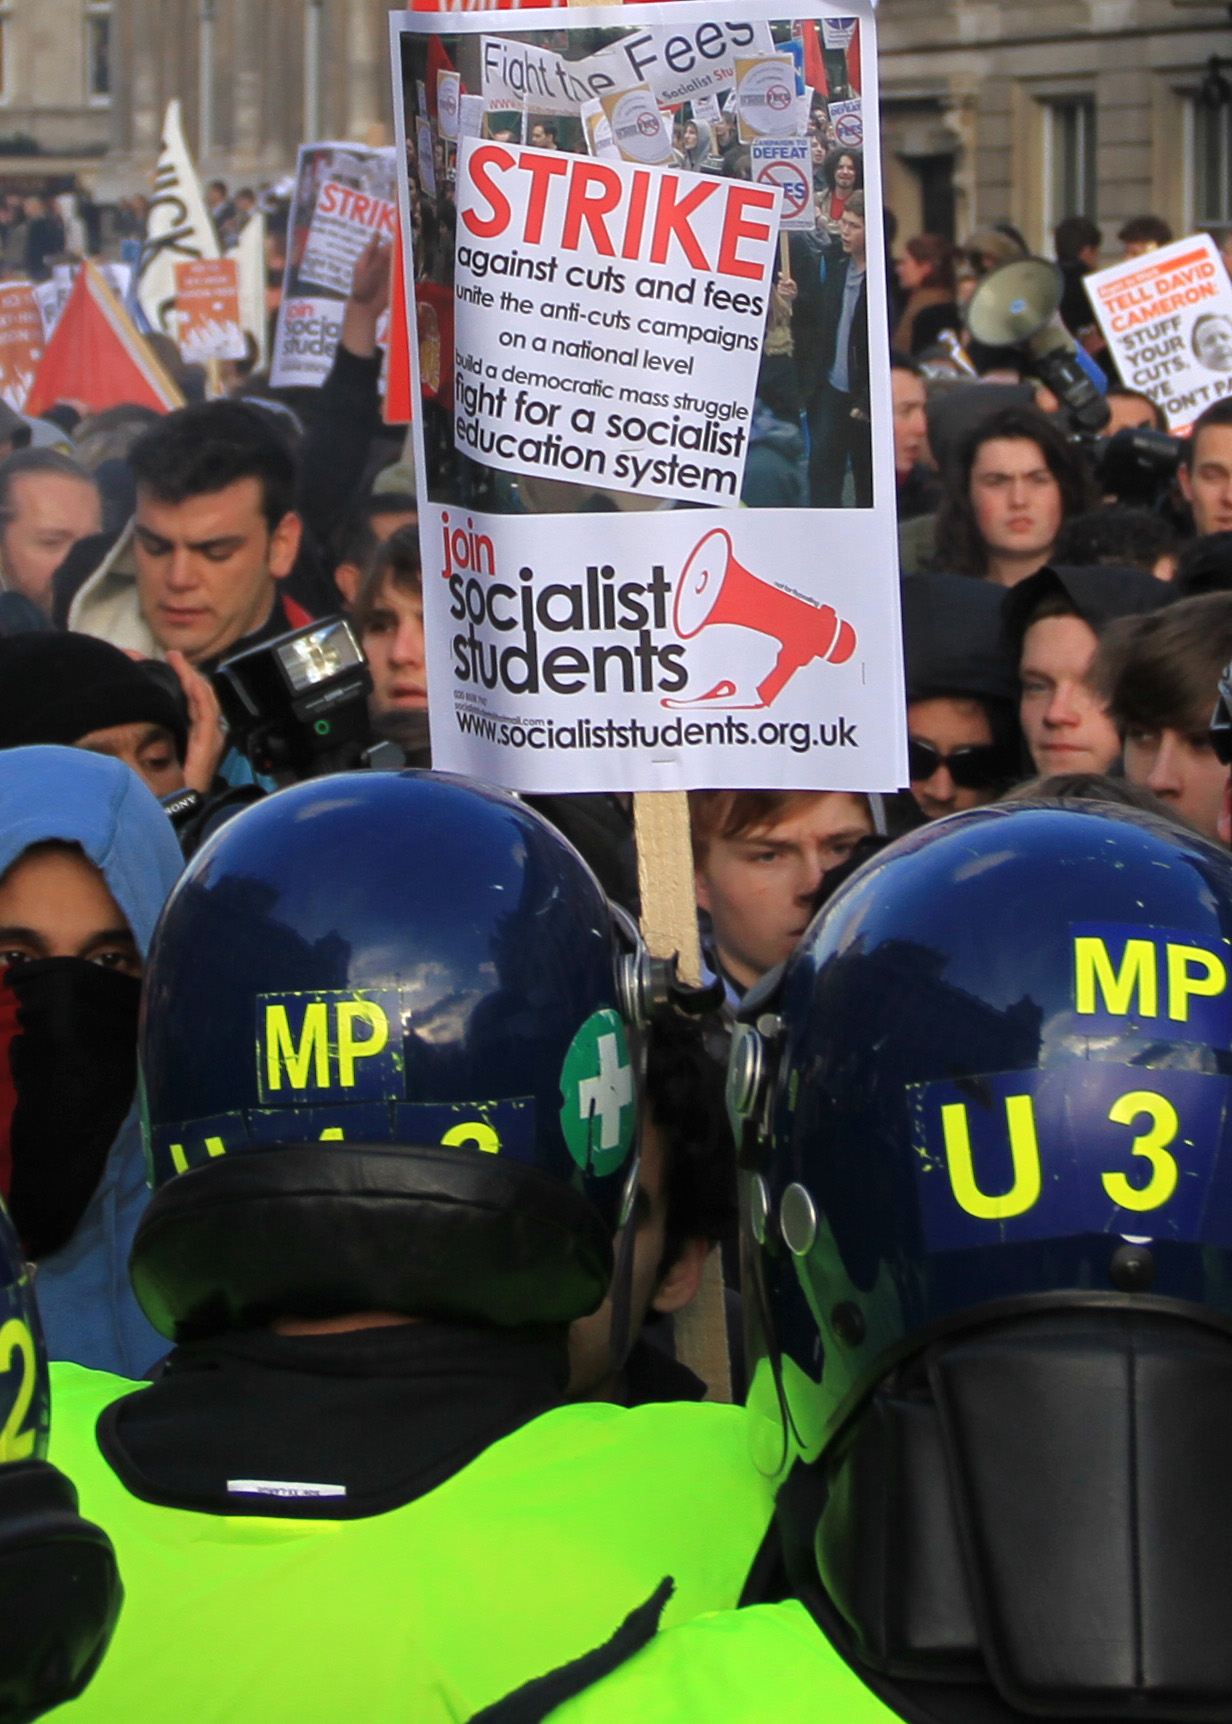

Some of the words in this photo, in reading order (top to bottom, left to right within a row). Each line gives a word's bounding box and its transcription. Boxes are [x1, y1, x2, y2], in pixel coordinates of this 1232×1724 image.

[484, 42, 555, 100] Fight
[555, 61, 616, 101] the
[623, 21, 755, 82] Fees
[661, 75, 713, 100] Socialist
[713, 66, 735, 81] Stu
[752, 147, 808, 159] DEFEAT
[319, 182, 397, 233] STRIK
[461, 145, 775, 281] STRIKE
[457, 246, 558, 283] against
[565, 266, 626, 294] cuts
[635, 278, 696, 304] and
[704, 281, 764, 316] fees
[1104, 288, 1154, 314] TELL
[1155, 262, 1216, 295] DAVID
[456, 284, 494, 308] unite
[500, 292, 534, 314] the
[540, 302, 631, 331] anti-cuts
[637, 319, 759, 352] campaigns
[1125, 336, 1186, 367] YOUR
[456, 352, 483, 376] build
[485, 365, 497, 379] a
[502, 366, 614, 399] democratic
[619, 388, 669, 407] mass
[674, 393, 749, 421] struggle
[499, 331, 526, 349] on
[532, 336, 547, 352] a
[552, 340, 639, 367] national
[643, 350, 694, 375] level
[456, 372, 506, 418] fight
[515, 390, 562, 427] for
[571, 408, 595, 434] a
[605, 414, 746, 458] socialist
[1161, 385, 1210, 414] ON'T
[456, 416, 606, 475] education
[613, 453, 738, 495] system
[441, 511, 496, 579] join
[448, 565, 671, 632] socialist
[453, 629, 689, 694] students
[456, 711, 858, 753] www.socialiststudents.org.uk
[1074, 937, 1227, 1022] MP
[265, 1001, 389, 1090] MP
[941, 1094, 1042, 1220] U
[1101, 1090, 1180, 1212] 3
[0, 1318, 36, 1463] 2
